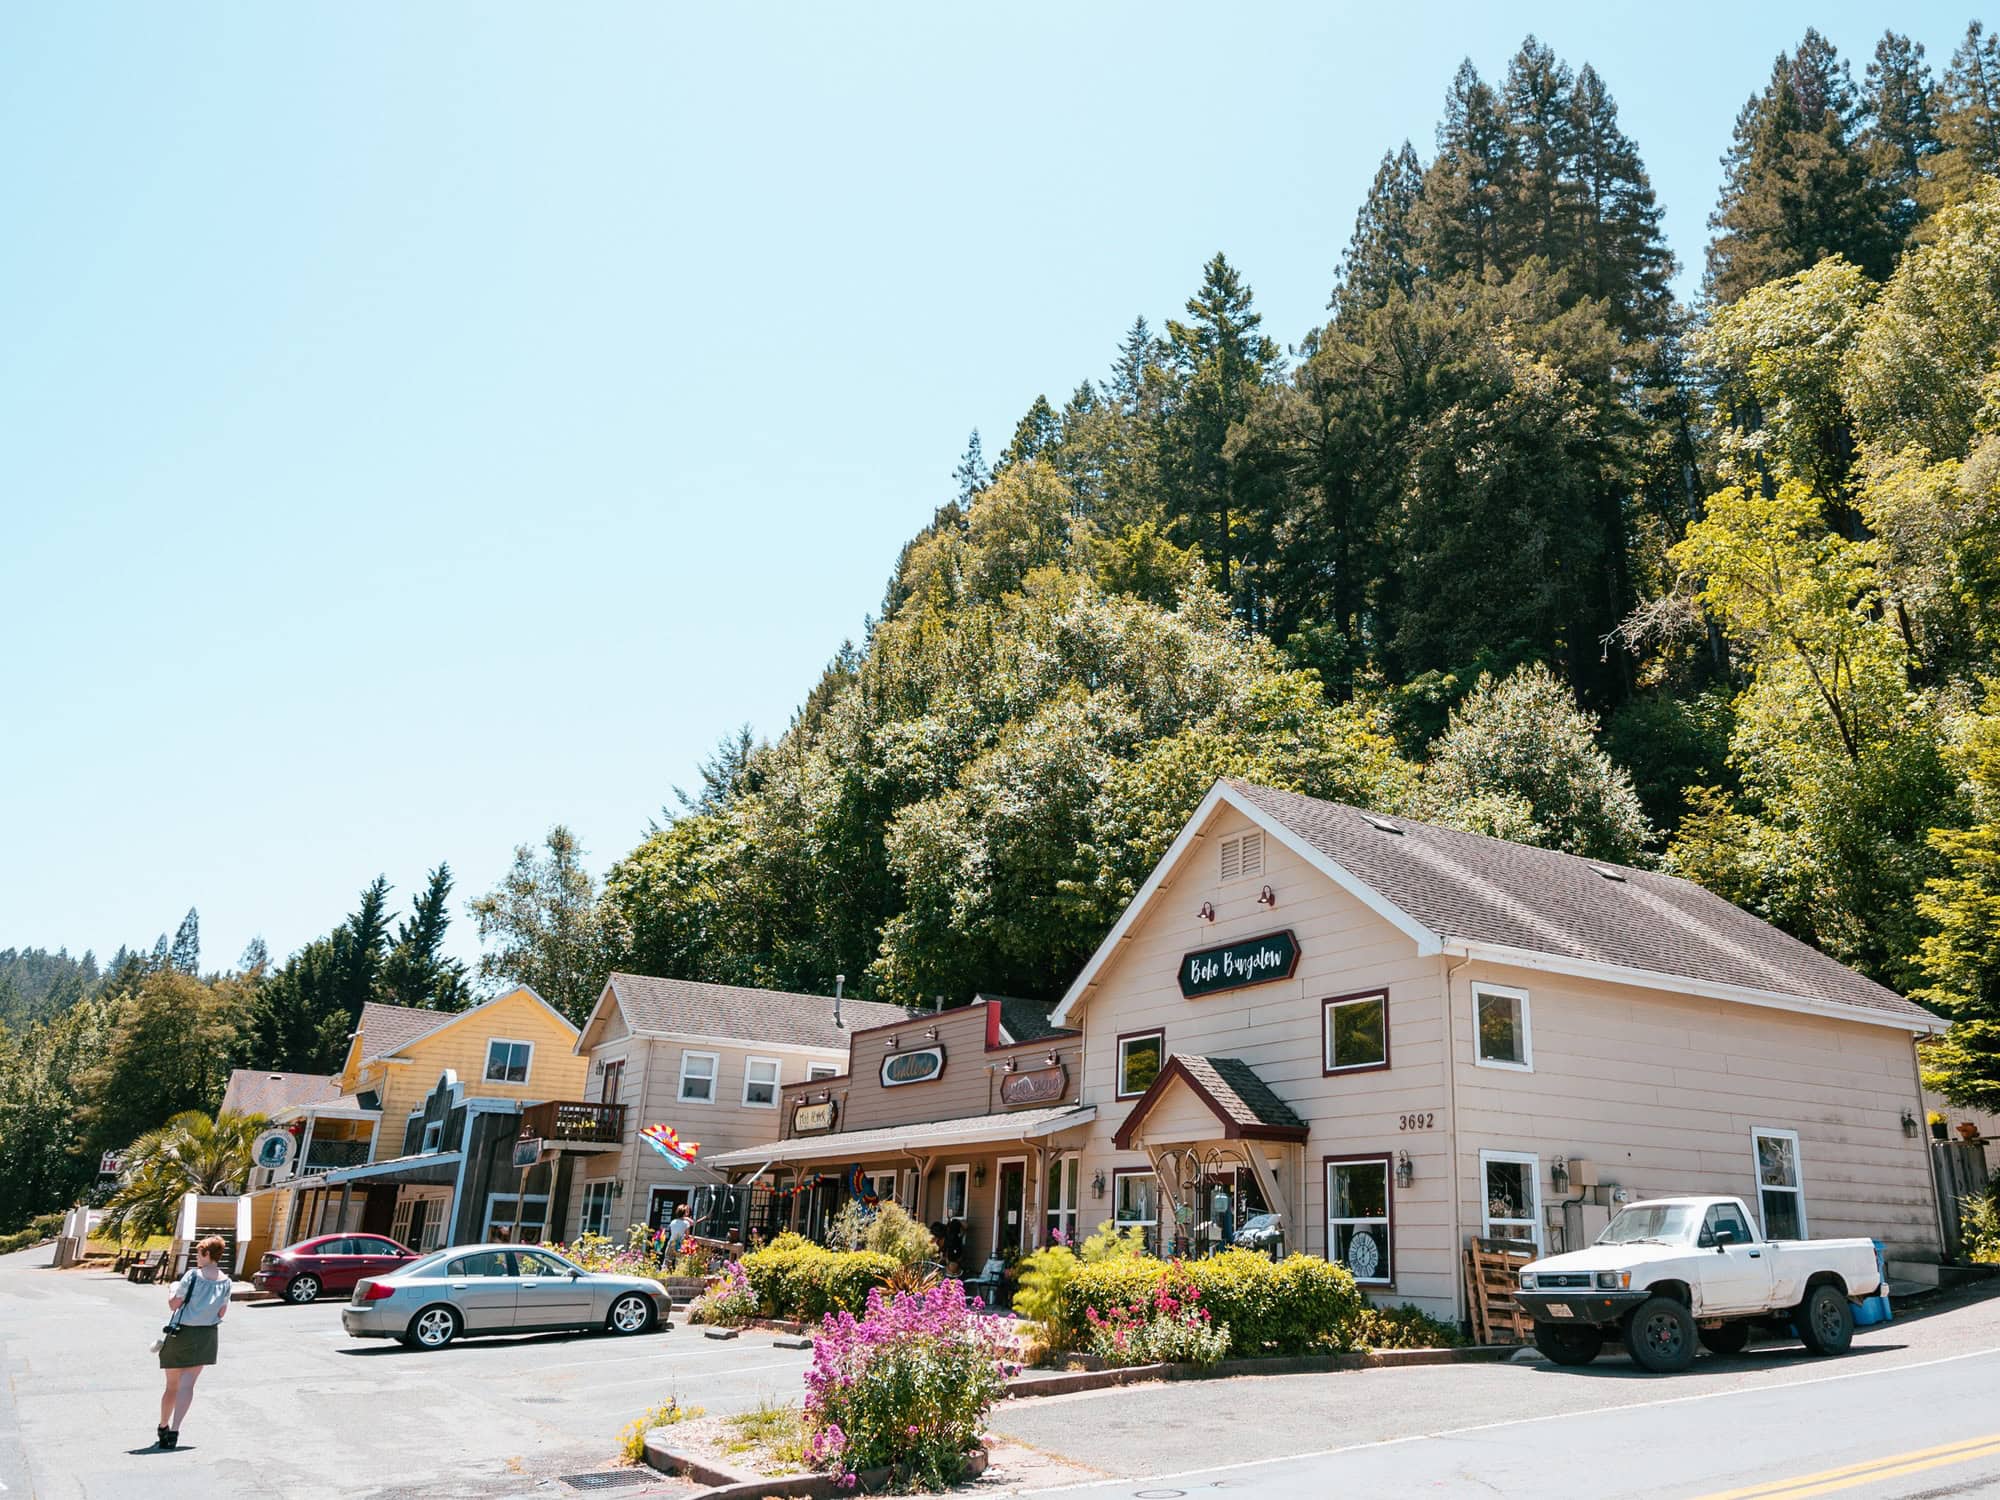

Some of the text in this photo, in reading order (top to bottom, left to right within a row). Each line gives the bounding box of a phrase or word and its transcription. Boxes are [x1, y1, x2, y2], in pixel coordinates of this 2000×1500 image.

[1191, 946, 1282, 984] Boho Bungalow
[1400, 1113, 1433, 1130] 3692
